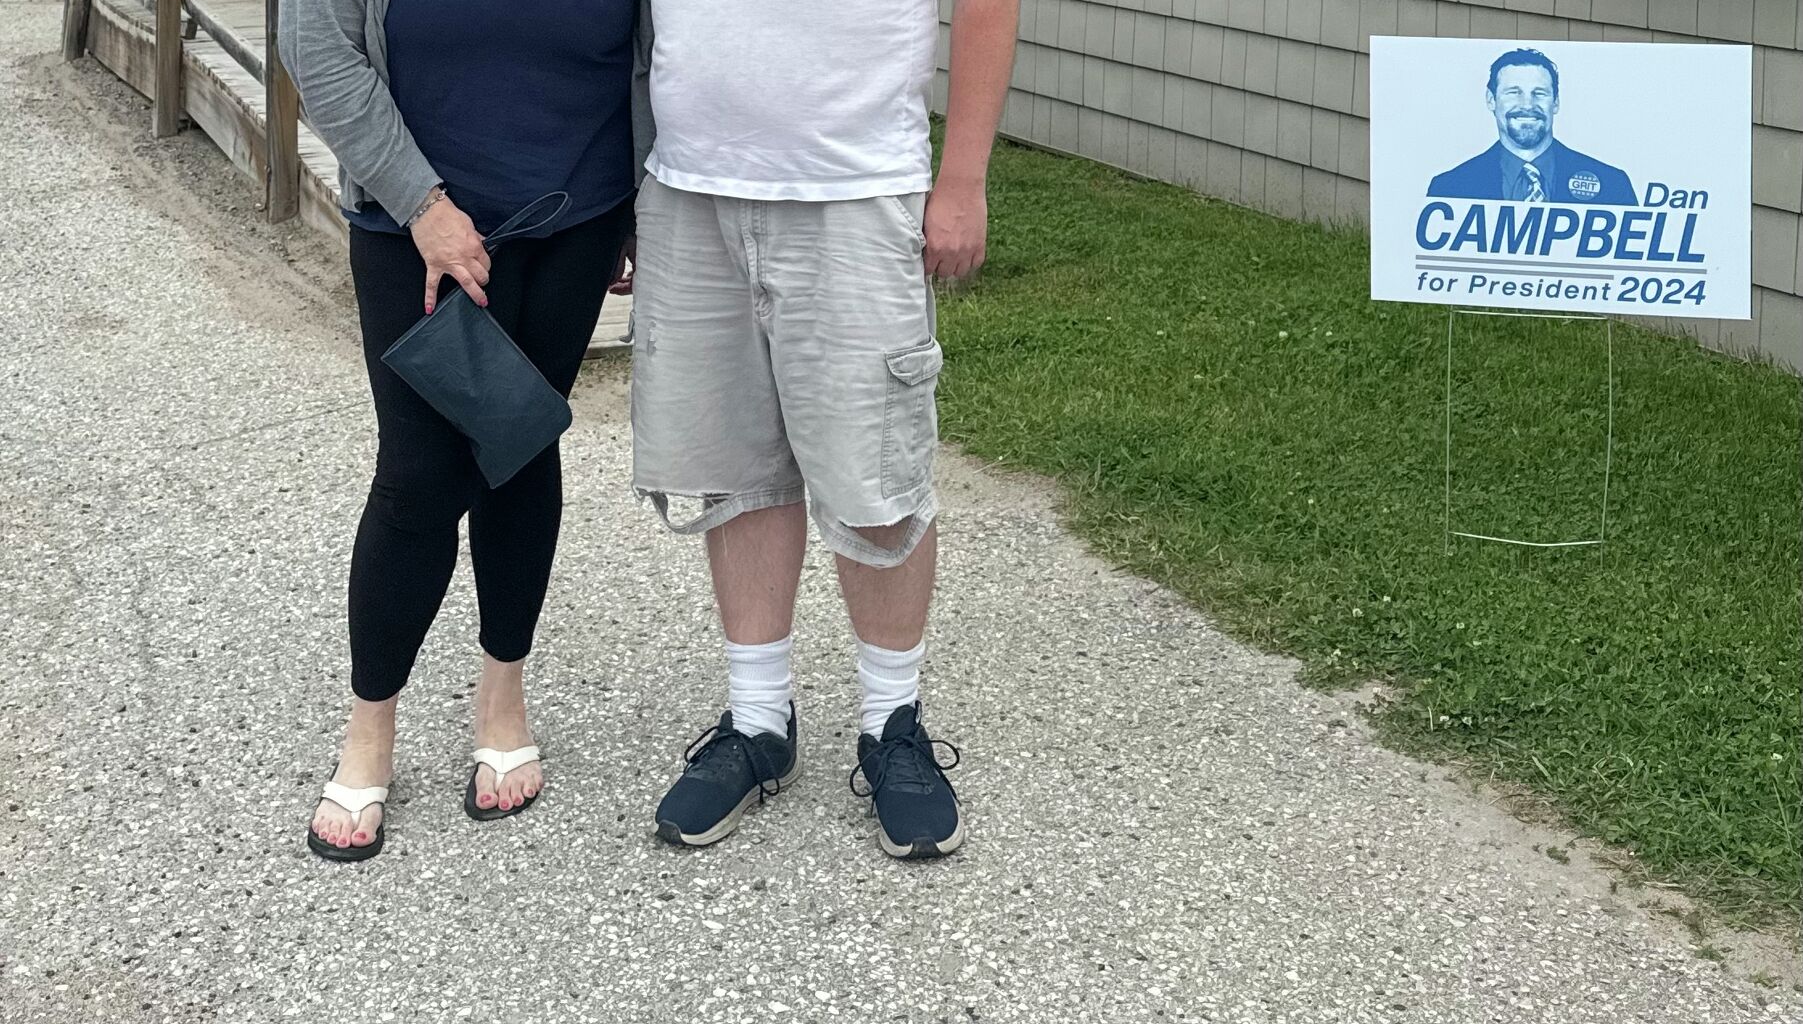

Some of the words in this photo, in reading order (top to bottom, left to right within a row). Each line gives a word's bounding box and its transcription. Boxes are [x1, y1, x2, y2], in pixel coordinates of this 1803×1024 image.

[1572, 180, 1598, 192] GRIT
[1643, 182, 1709, 210] Dan
[1415, 201, 1707, 263] CAMPBELL
[1417, 272, 1459, 292] for
[1468, 275, 1612, 302] President
[1617, 276, 1707, 306] 2024
